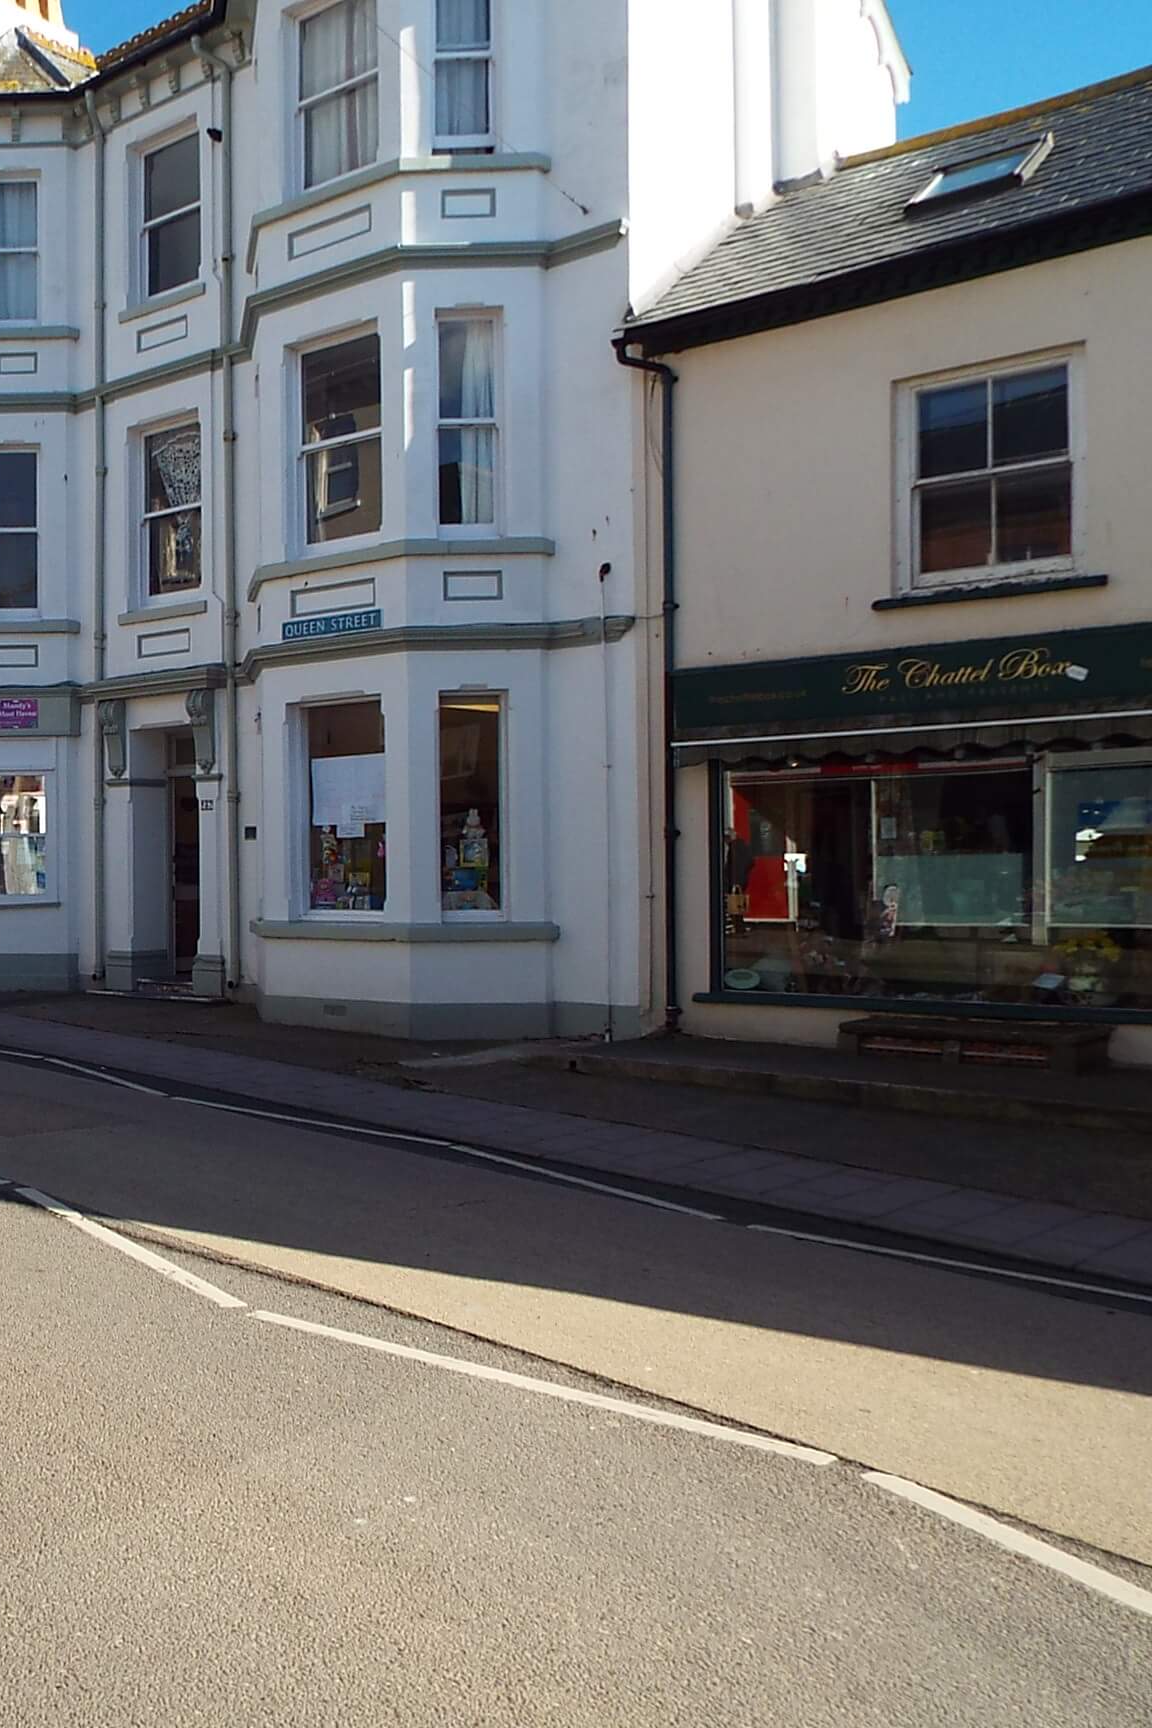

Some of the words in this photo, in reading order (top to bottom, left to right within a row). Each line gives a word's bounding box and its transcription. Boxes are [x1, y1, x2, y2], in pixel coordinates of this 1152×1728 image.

[285, 620, 325, 637] QUEEN
[330, 613, 376, 631] STREET
[841, 663, 890, 694] The
[897, 658, 995, 688] Chattel
[998, 648, 1071, 680] Box
